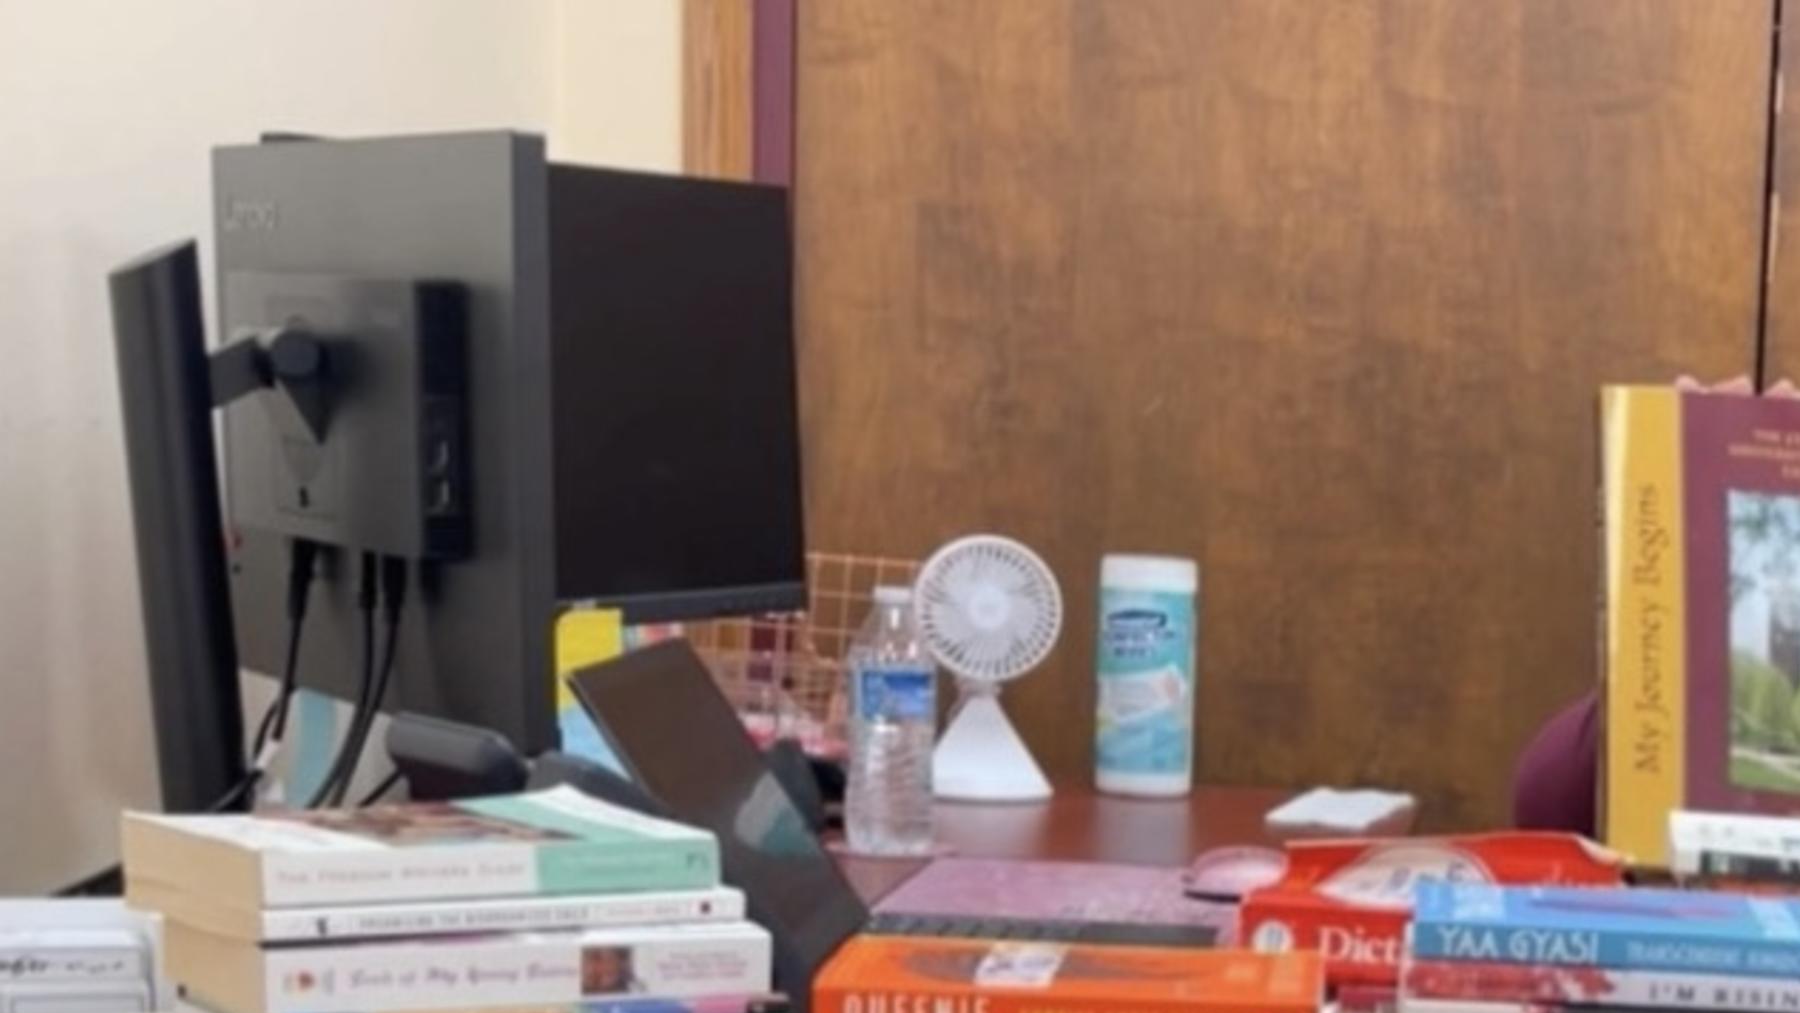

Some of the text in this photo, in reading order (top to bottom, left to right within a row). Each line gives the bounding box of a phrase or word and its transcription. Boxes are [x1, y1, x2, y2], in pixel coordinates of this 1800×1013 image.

[1632, 482, 1672, 775] My Journey Begins
[1317, 925, 1397, 967] Dict
[1440, 926, 1498, 956] YAA
[1509, 927, 1600, 962] GYASI
[1650, 985, 1696, 1001] I'M
